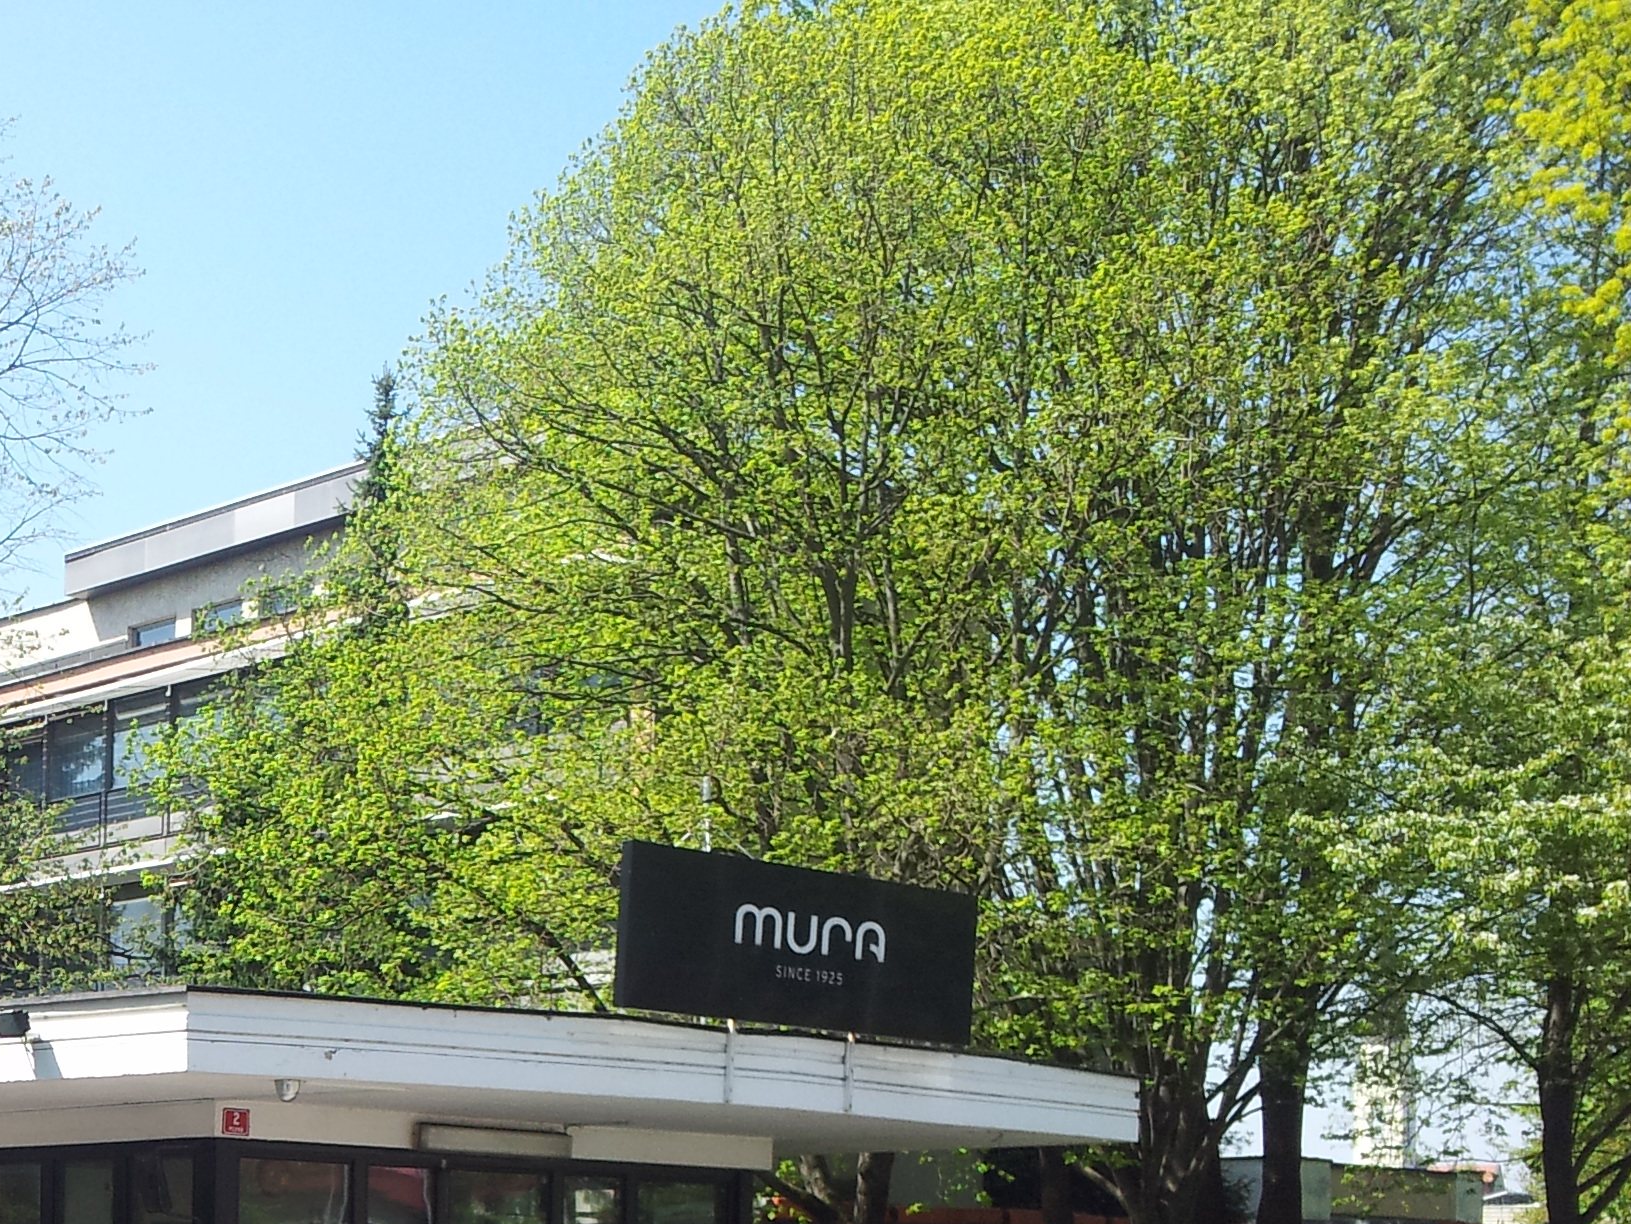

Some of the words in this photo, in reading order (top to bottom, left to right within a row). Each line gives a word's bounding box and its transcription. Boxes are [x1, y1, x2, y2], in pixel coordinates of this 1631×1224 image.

[775, 965, 812, 982] SINCE
[816, 970, 844, 986] 1925
[233, 1111, 241, 1126] 2
